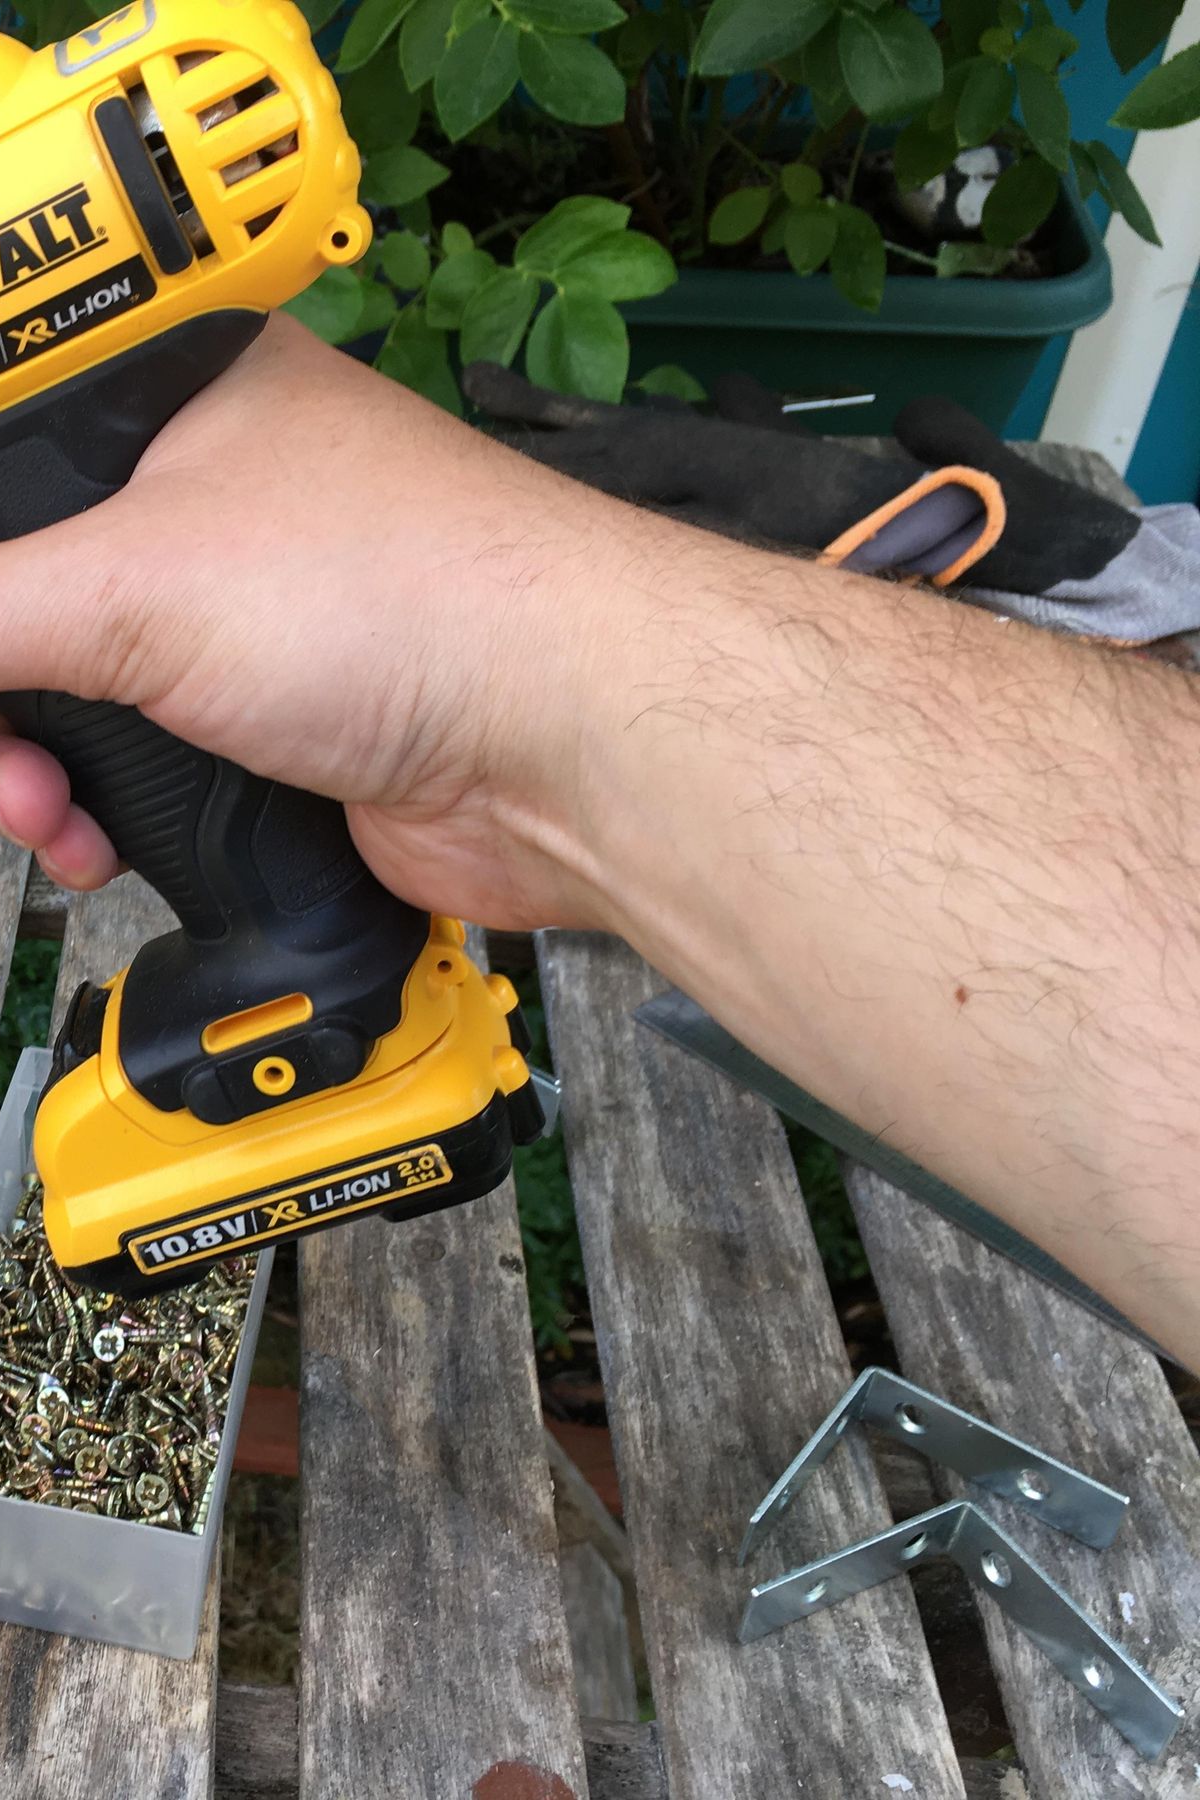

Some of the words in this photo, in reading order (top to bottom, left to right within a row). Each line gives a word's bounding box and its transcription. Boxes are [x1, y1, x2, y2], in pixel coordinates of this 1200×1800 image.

[7, 317, 57, 356] XR
[53, 277, 132, 331] LI-ION
[144, 1216, 247, 1264] 10.8V
[261, 1199, 307, 1228] XR
[309, 1171, 391, 1212] LI-ION
[397, 1155, 436, 1178] 2.0
[406, 1169, 437, 1187] AH
